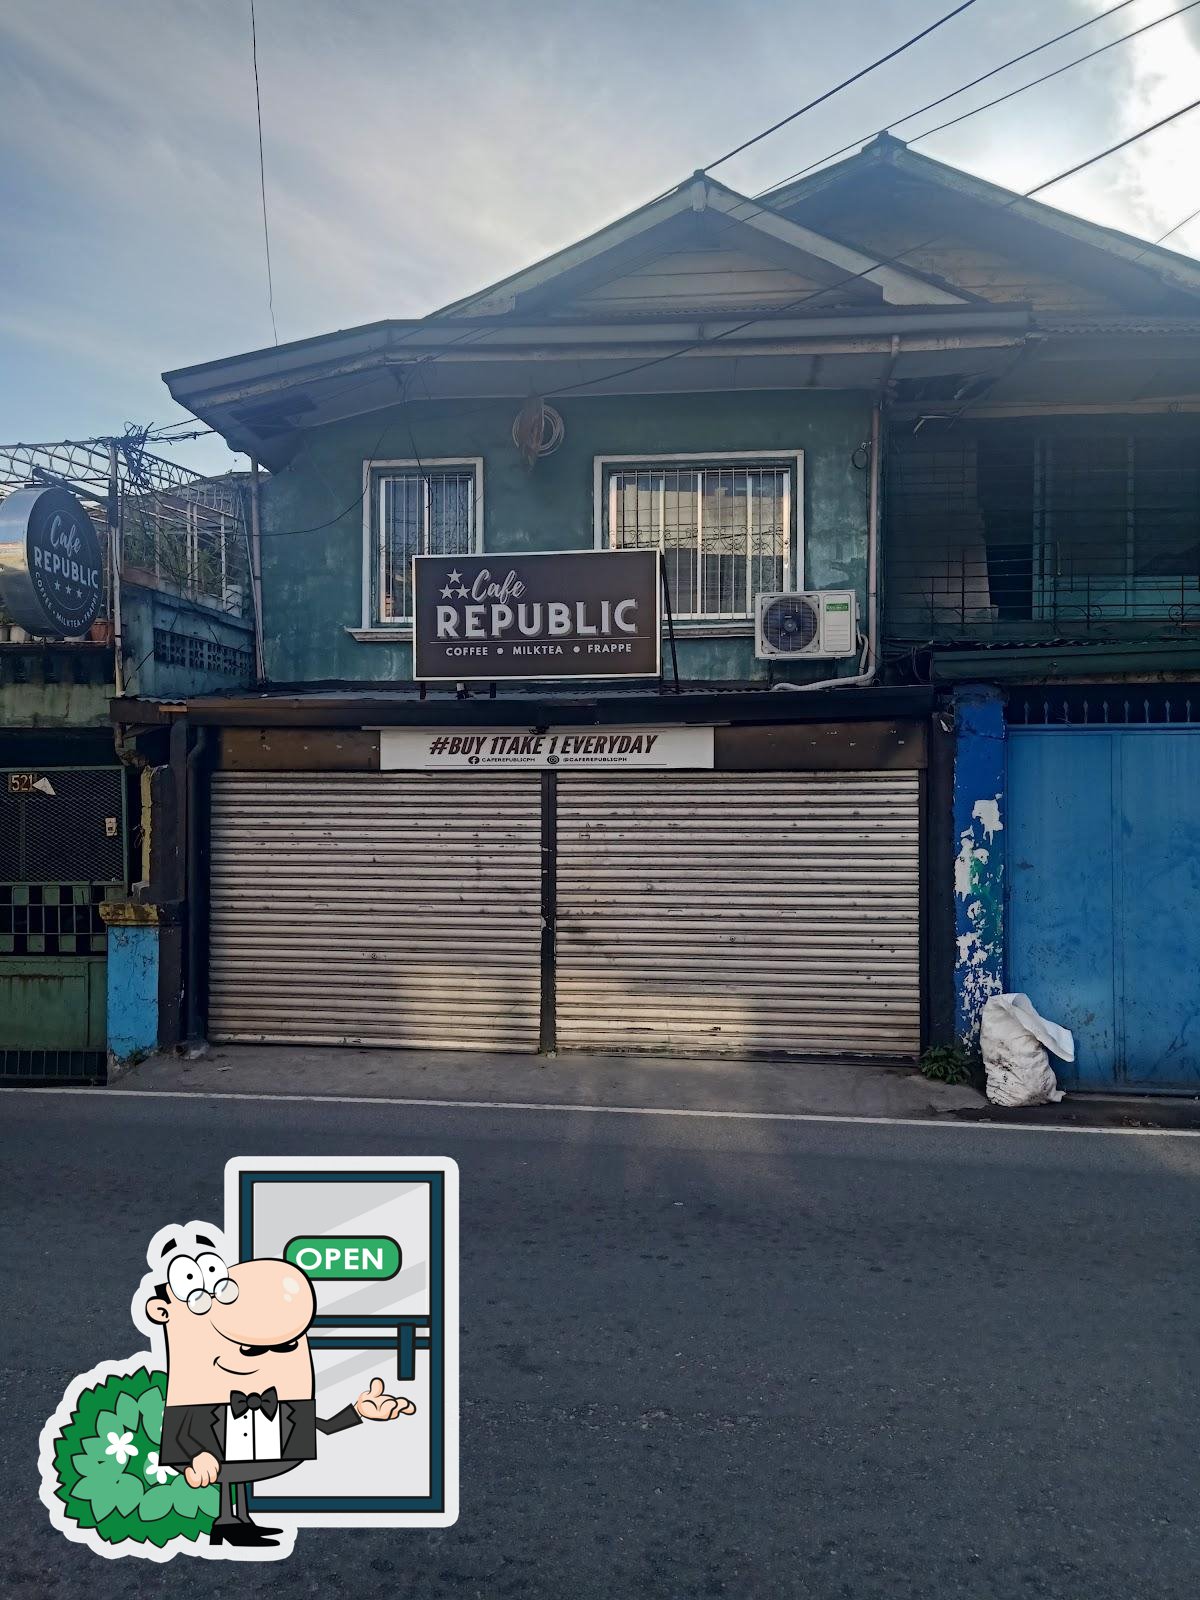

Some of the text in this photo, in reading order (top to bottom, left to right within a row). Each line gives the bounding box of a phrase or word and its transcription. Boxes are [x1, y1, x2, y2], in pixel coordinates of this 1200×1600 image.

[50, 514, 82, 558] Cafe
[33, 545, 99, 590] REPUBLIC
[471, 568, 527, 604] Cafe
[436, 598, 639, 639] REPUBLIC
[445, 643, 632, 656] COFFEE MILKTEA FRAPPE
[429, 736, 488, 755] #BUY
[548, 735, 559, 755] 1
[560, 734, 660, 754] EVERYDAY
[11, 774, 33, 791] 521
